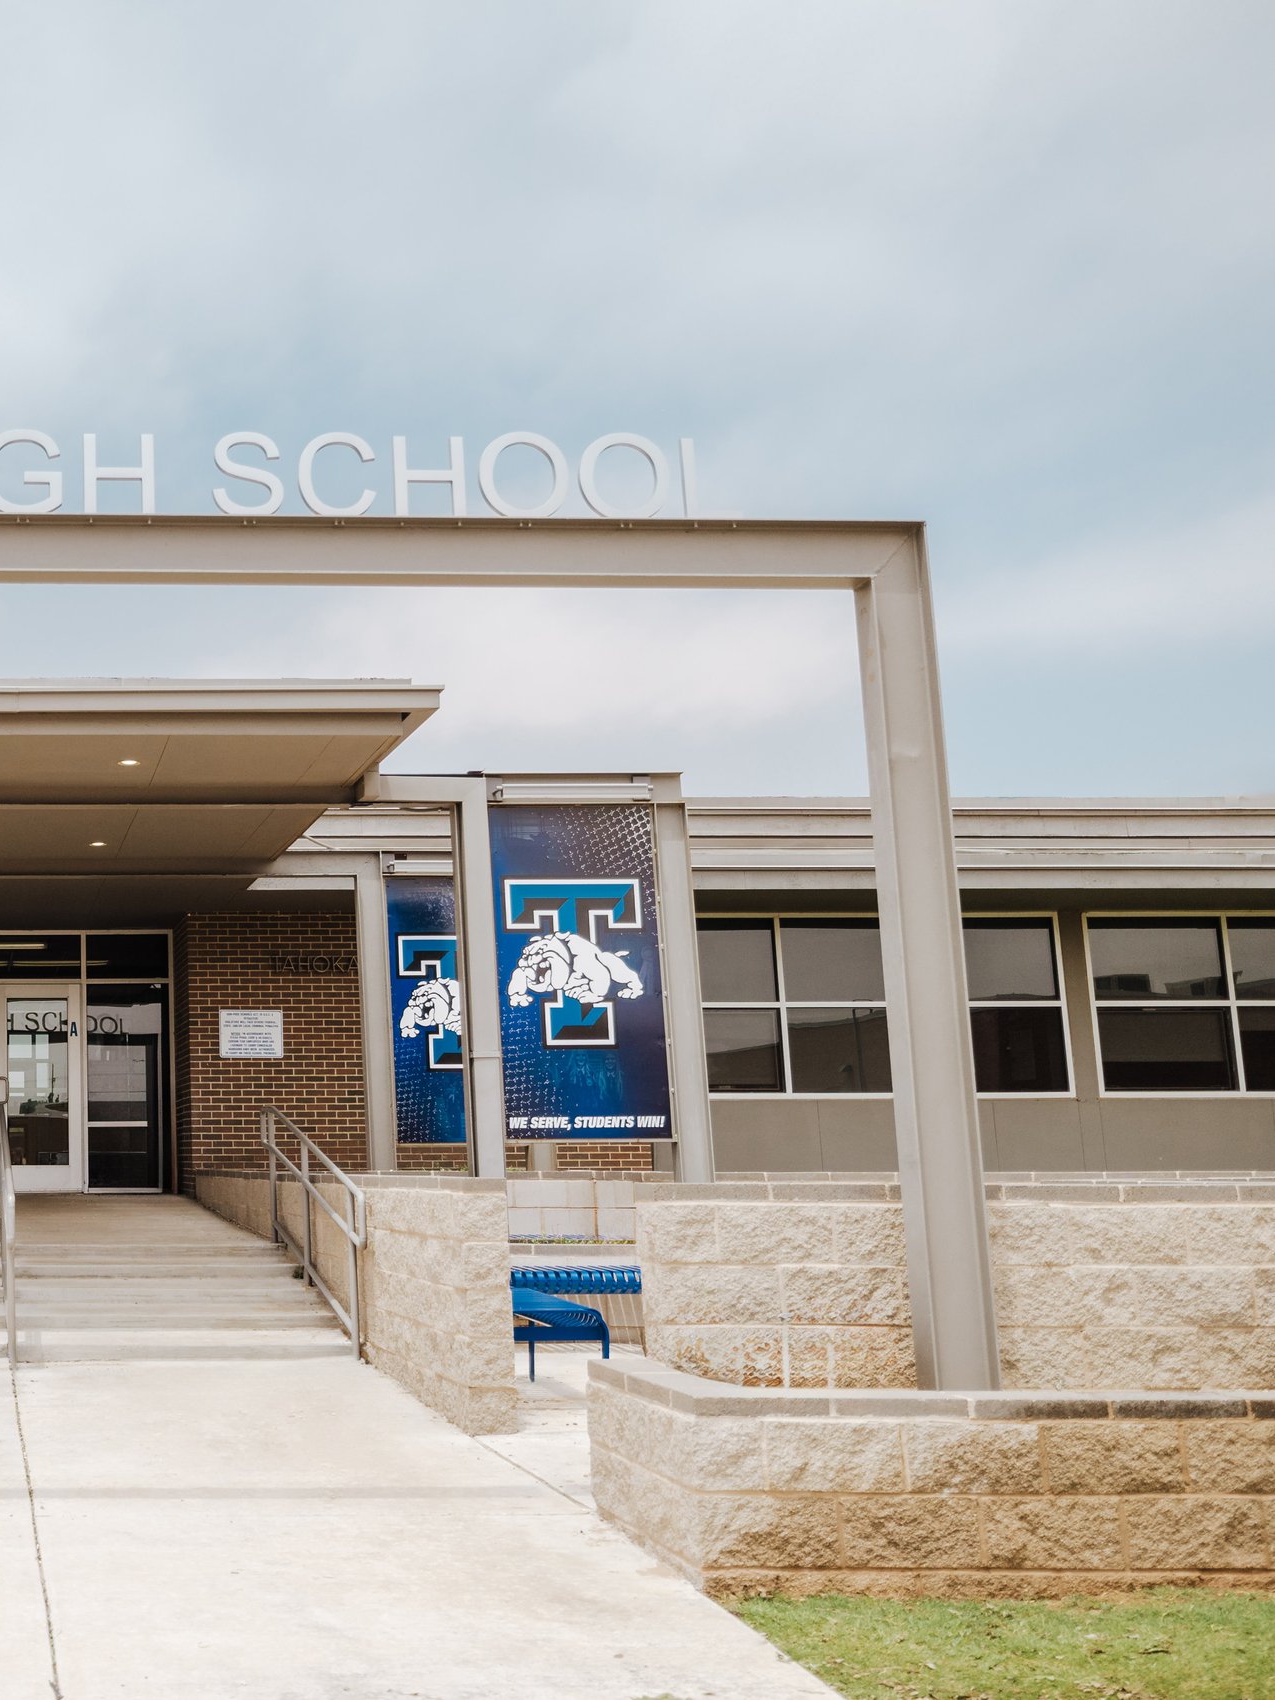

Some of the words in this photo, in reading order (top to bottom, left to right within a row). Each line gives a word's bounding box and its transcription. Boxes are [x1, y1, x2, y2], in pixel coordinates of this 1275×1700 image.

[270, 955, 358, 973] TAHOKA
[504, 878, 642, 1046] T
[69, 1021, 78, 1037] A
[509, 1116, 529, 1129] WE
[530, 1116, 572, 1131] SERVE,
[574, 1115, 635, 1129] STUDENTS
[637, 1115, 666, 1128] WIN!
